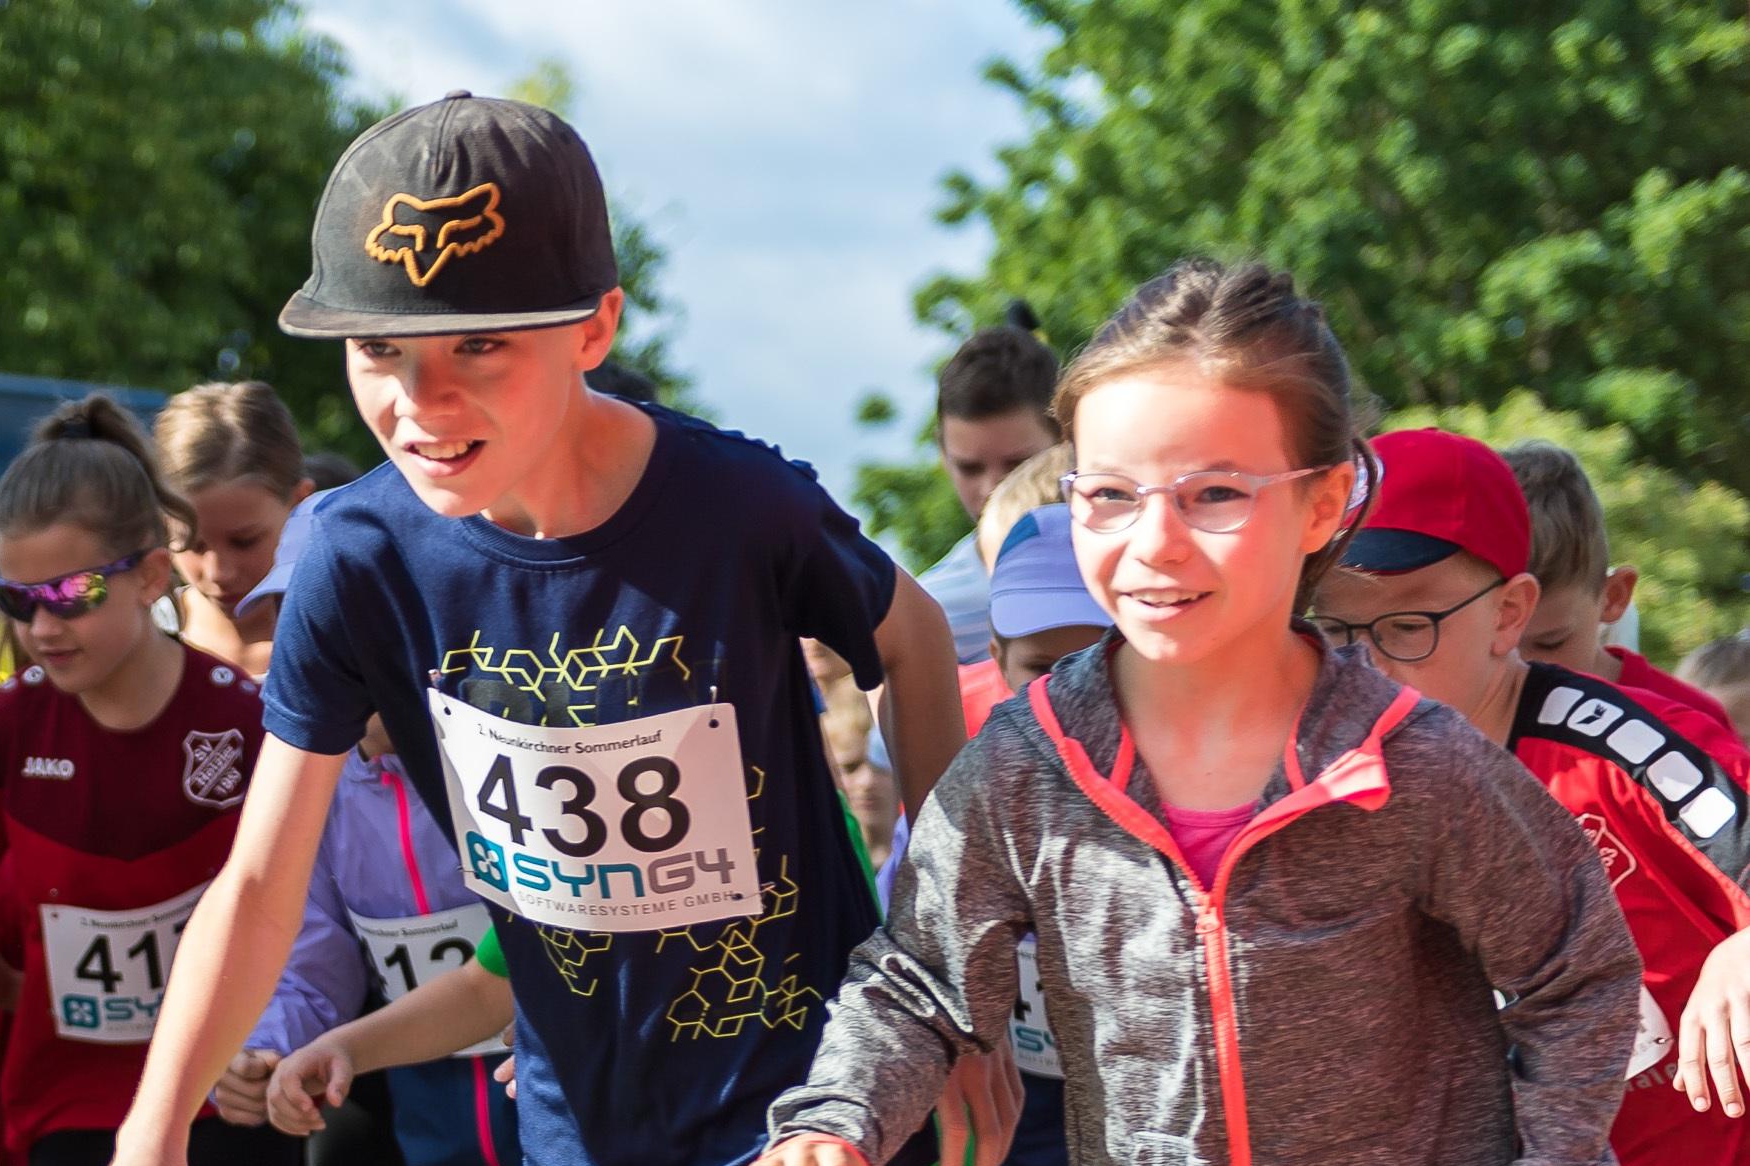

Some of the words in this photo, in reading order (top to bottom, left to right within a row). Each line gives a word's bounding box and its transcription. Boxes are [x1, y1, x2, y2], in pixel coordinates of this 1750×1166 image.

[489, 729, 572, 755] Neunkirchner
[574, 729, 664, 755] Sommerlauf
[22, 756, 75, 779] JAKO
[476, 753, 691, 858] 438
[517, 889, 677, 917] SOFTWARESYSTEME
[684, 890, 735, 908] GMBH
[76, 920, 188, 993] 41
